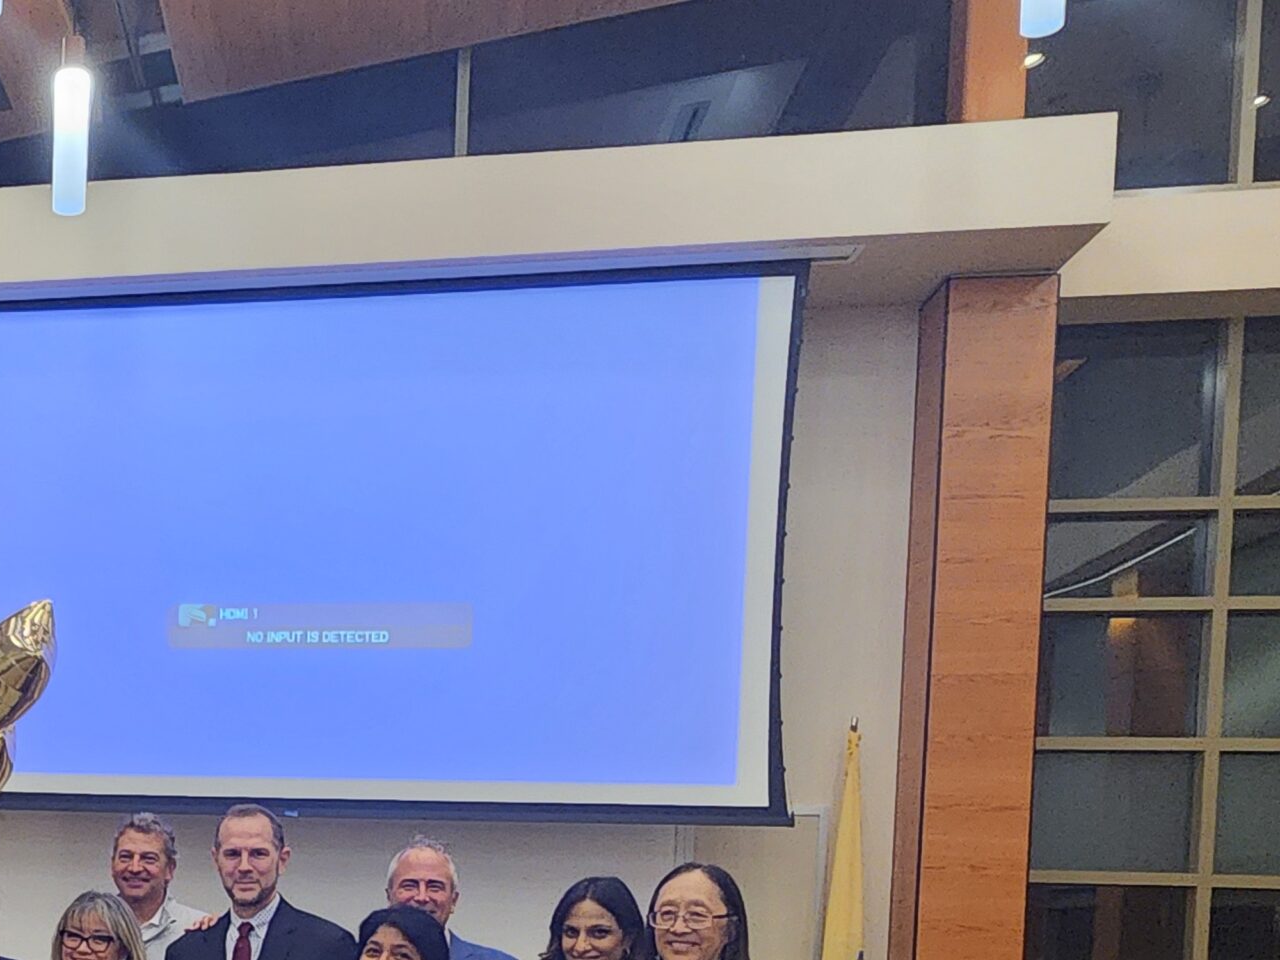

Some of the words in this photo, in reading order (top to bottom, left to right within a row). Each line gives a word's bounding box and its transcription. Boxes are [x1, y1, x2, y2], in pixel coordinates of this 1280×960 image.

[220, 607, 249, 620] HDMI
[253, 607, 258, 620] 1
[246, 631, 263, 643] NO
[266, 631, 303, 643] INPUT
[306, 631, 320, 643] IS
[322, 631, 389, 643] DETECTED
